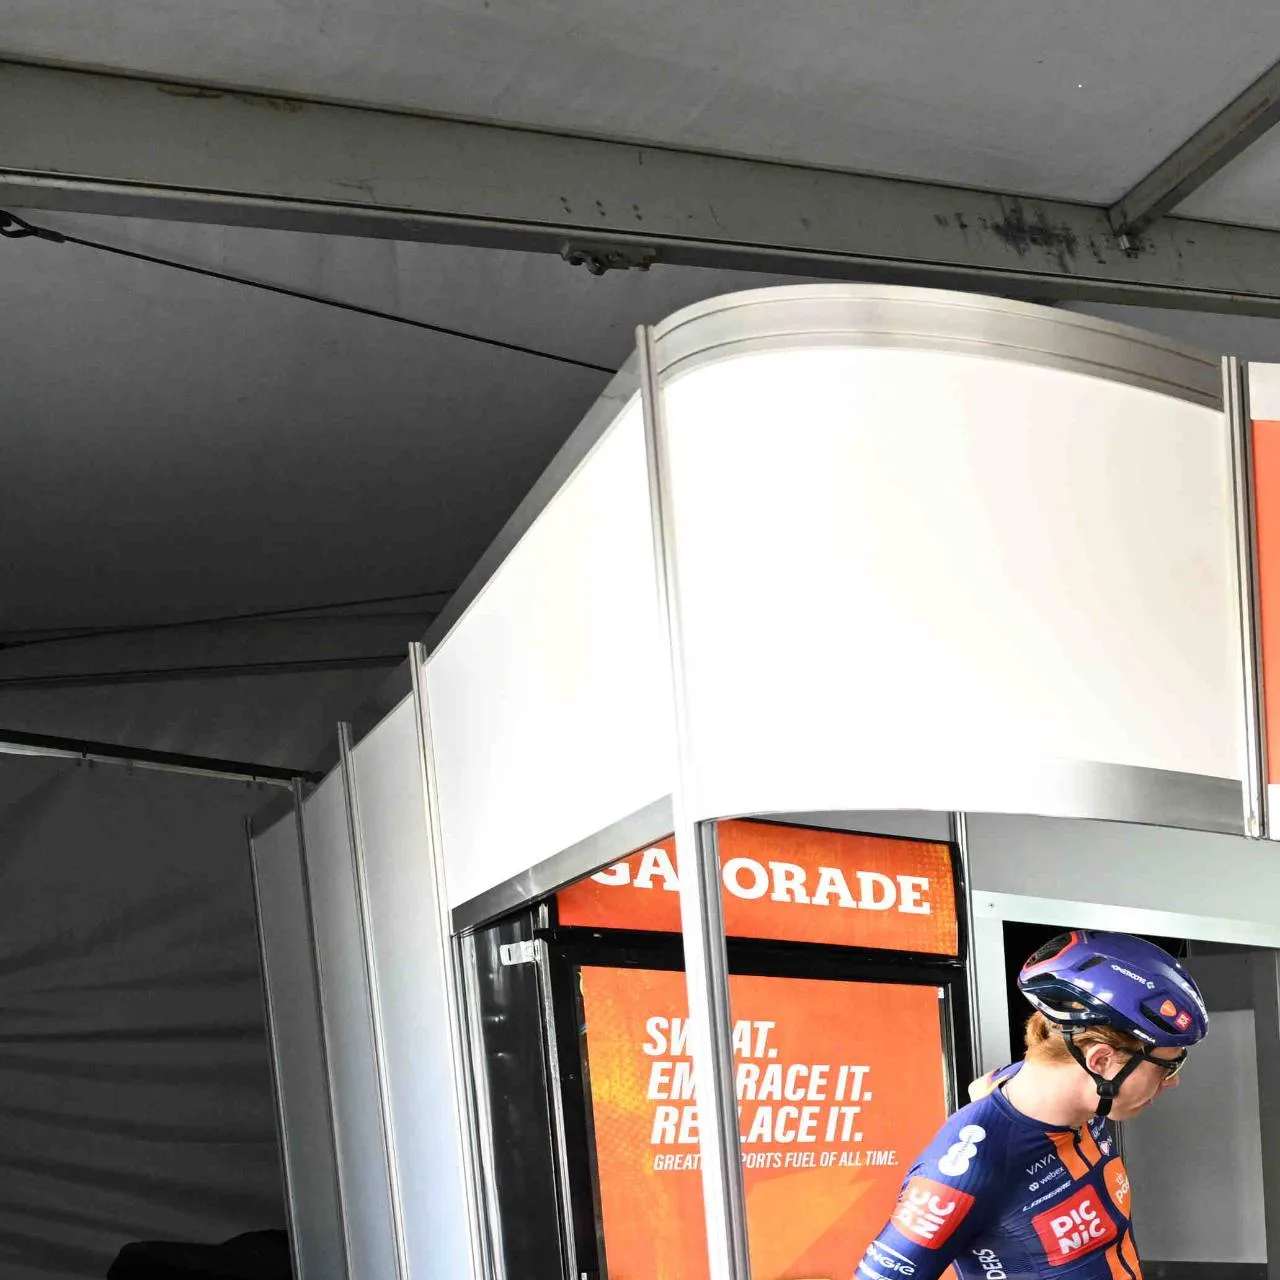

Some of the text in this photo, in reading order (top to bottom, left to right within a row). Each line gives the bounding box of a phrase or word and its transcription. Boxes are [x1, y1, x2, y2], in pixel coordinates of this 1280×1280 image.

[590, 848, 931, 914] GAORADE
[643, 1016, 778, 1058] SWAT.
[646, 1062, 873, 1102] EMRACE IT.
[650, 1106, 863, 1145] RELACE IT.
[653, 1150, 899, 1170] GREAT PORTS FUEL OF ALL TIME.
[1026, 1153, 1056, 1175] VAYA
[1040, 1166, 1064, 1185] webex
[1050, 1200, 1097, 1238] PIC
